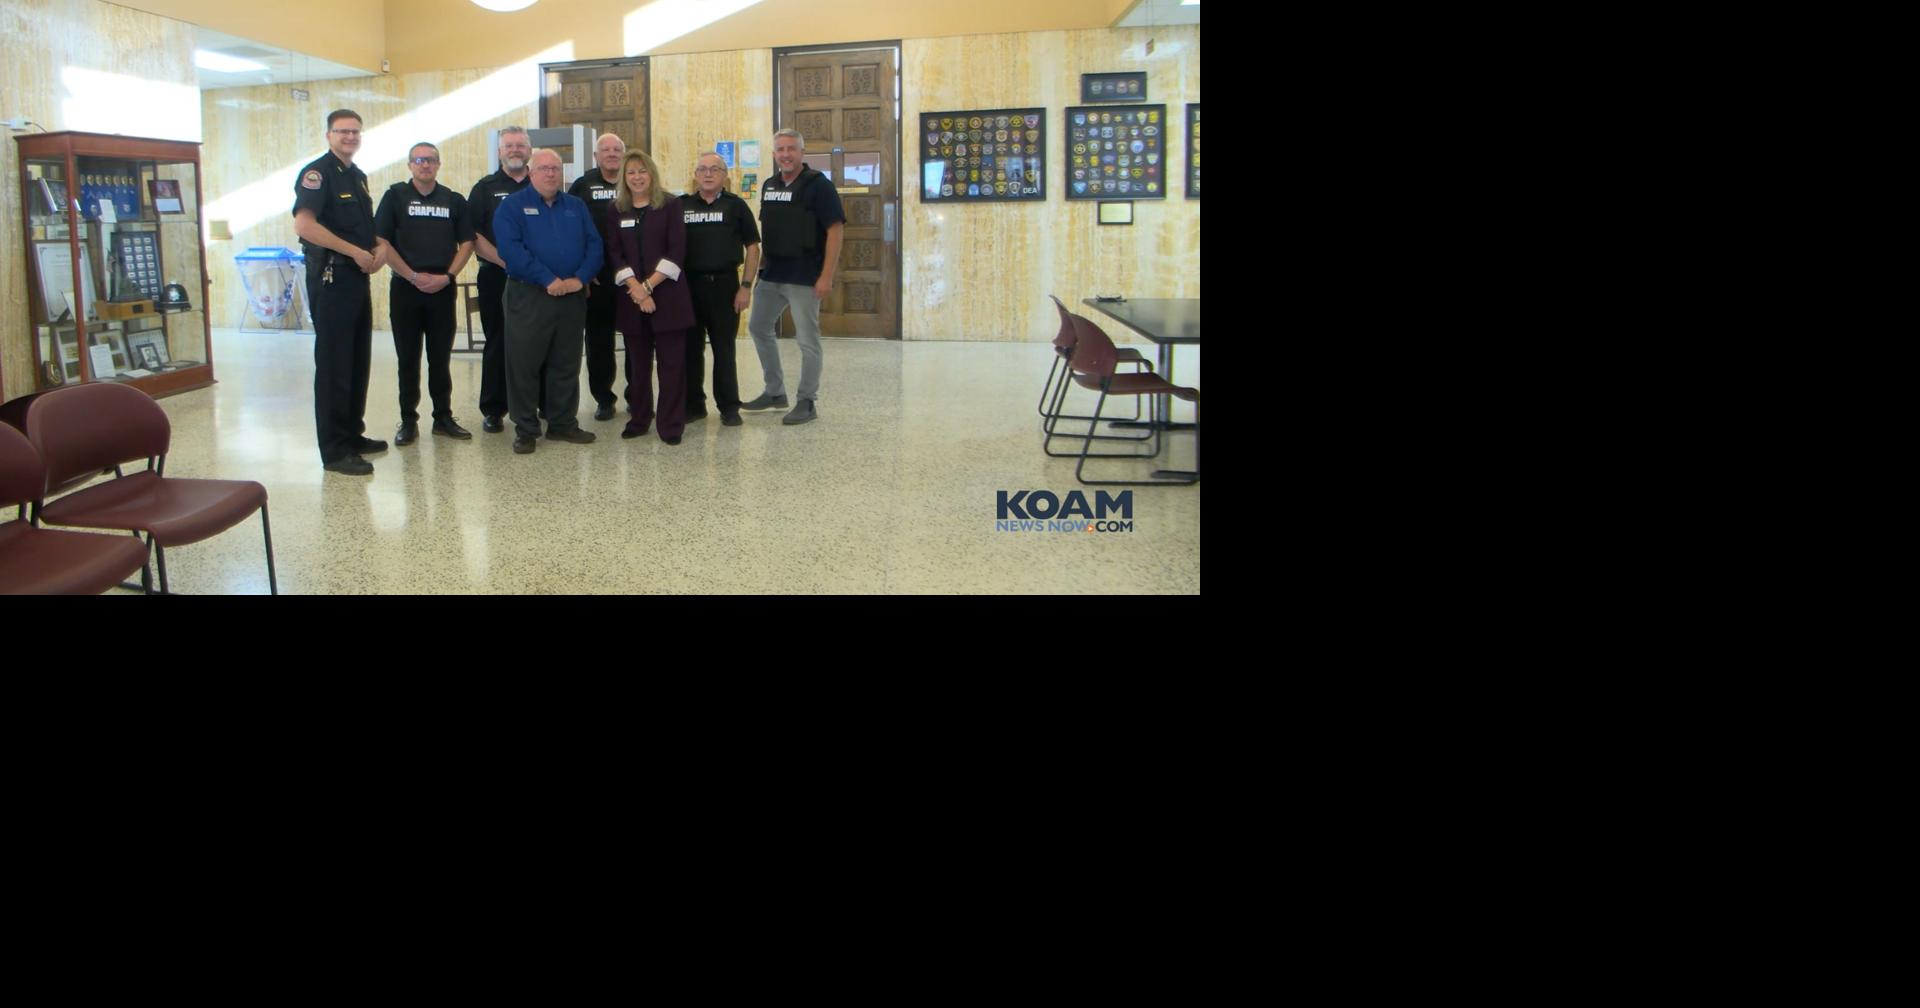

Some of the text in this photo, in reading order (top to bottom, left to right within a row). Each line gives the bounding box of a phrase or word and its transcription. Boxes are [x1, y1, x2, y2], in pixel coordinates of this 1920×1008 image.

[764, 191, 793, 202] CHAPLAIN
[408, 205, 450, 218] CHAPLAIN
[684, 212, 723, 224] CHAPLAIN
